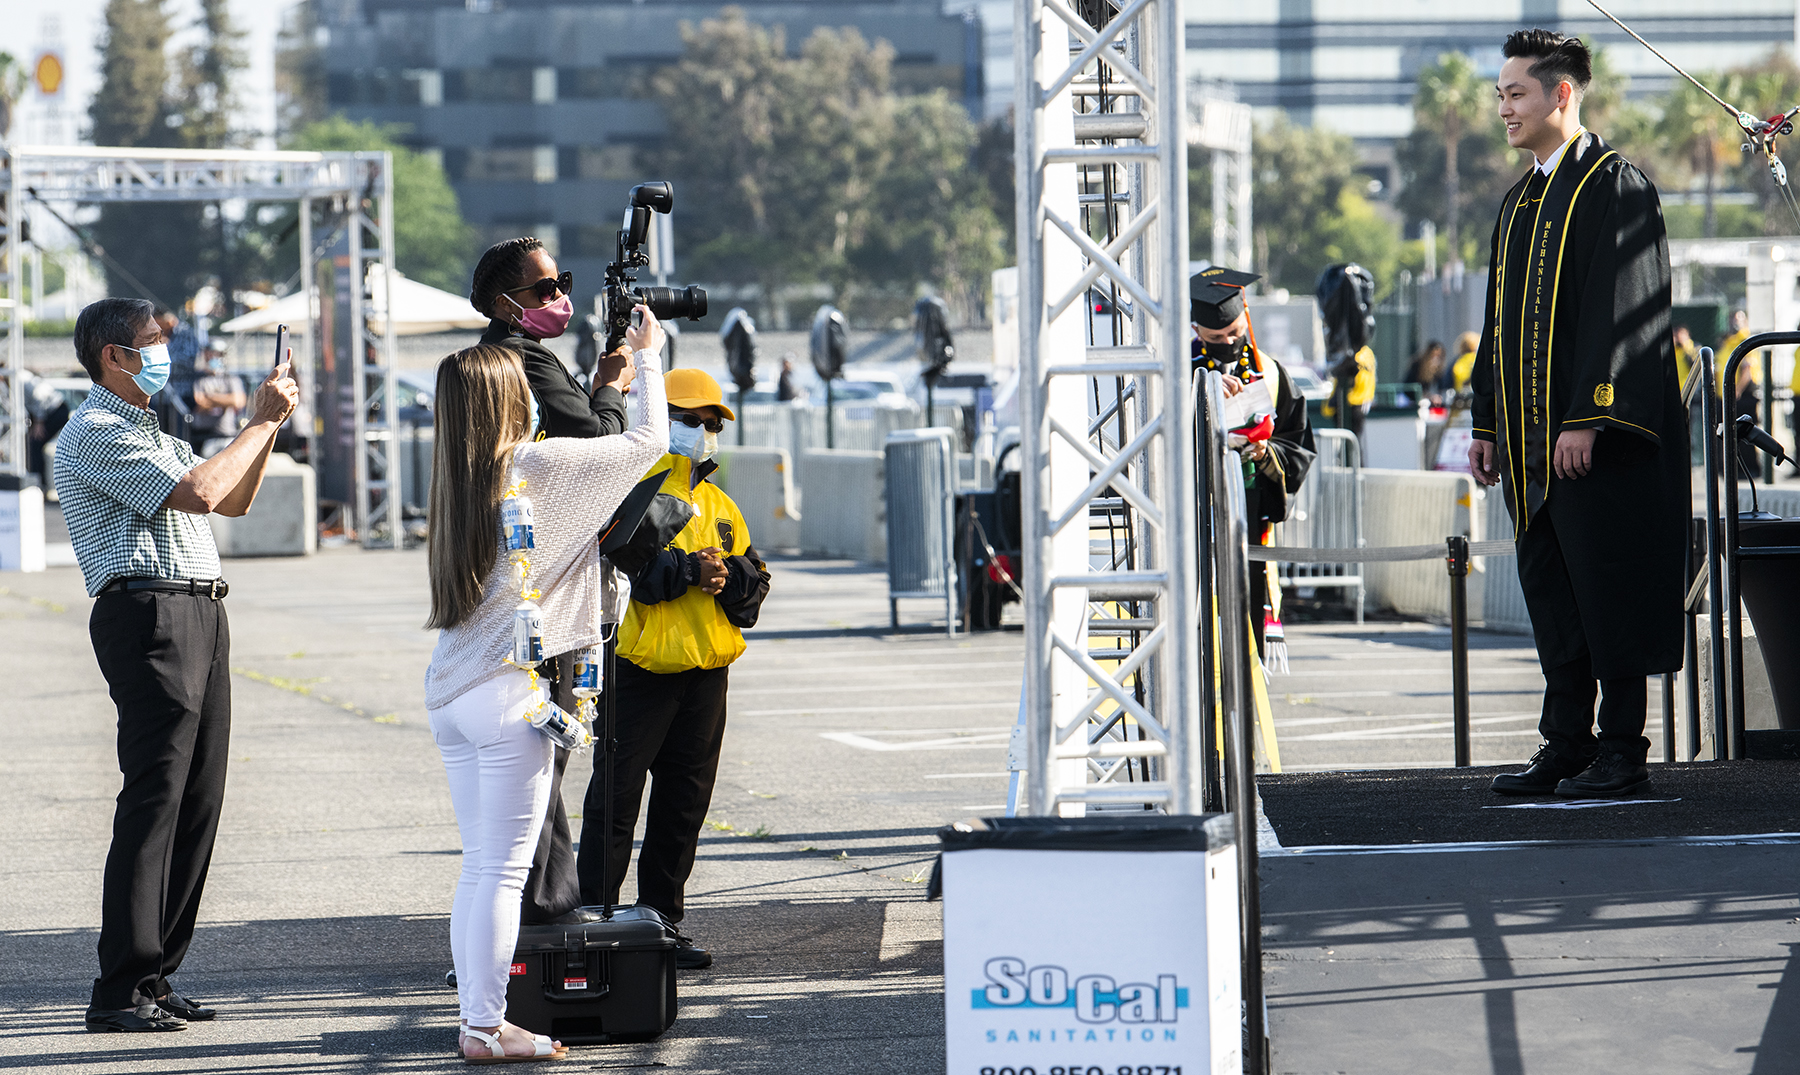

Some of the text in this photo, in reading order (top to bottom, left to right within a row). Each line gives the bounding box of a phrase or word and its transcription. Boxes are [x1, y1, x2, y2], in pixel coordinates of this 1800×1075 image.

[1532, 220, 1552, 425] MECHANICAL ENGINEERING
[985, 1029, 1177, 1042] SANITATION
